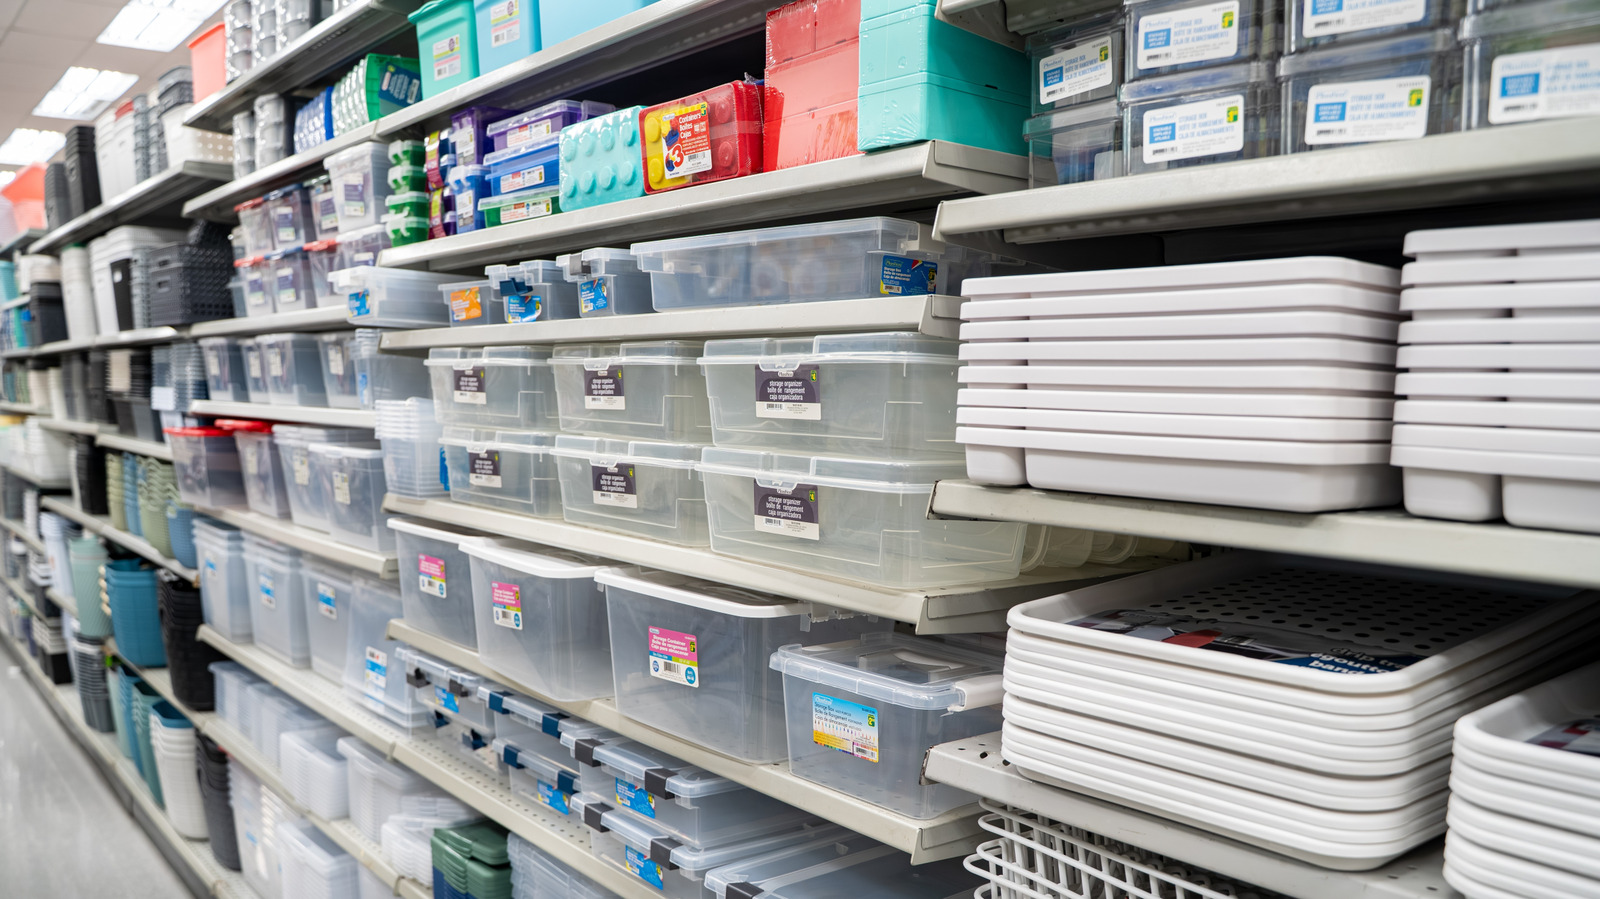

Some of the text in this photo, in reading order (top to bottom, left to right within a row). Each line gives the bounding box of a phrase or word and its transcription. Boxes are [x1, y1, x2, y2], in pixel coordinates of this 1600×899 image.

[679, 113, 701, 123] Containers
[777, 511, 801, 519] organizadora
[667, 638, 685, 646] Container
[669, 648, 688, 656] almacenar
[1331, 648, 1375, 662] drip
